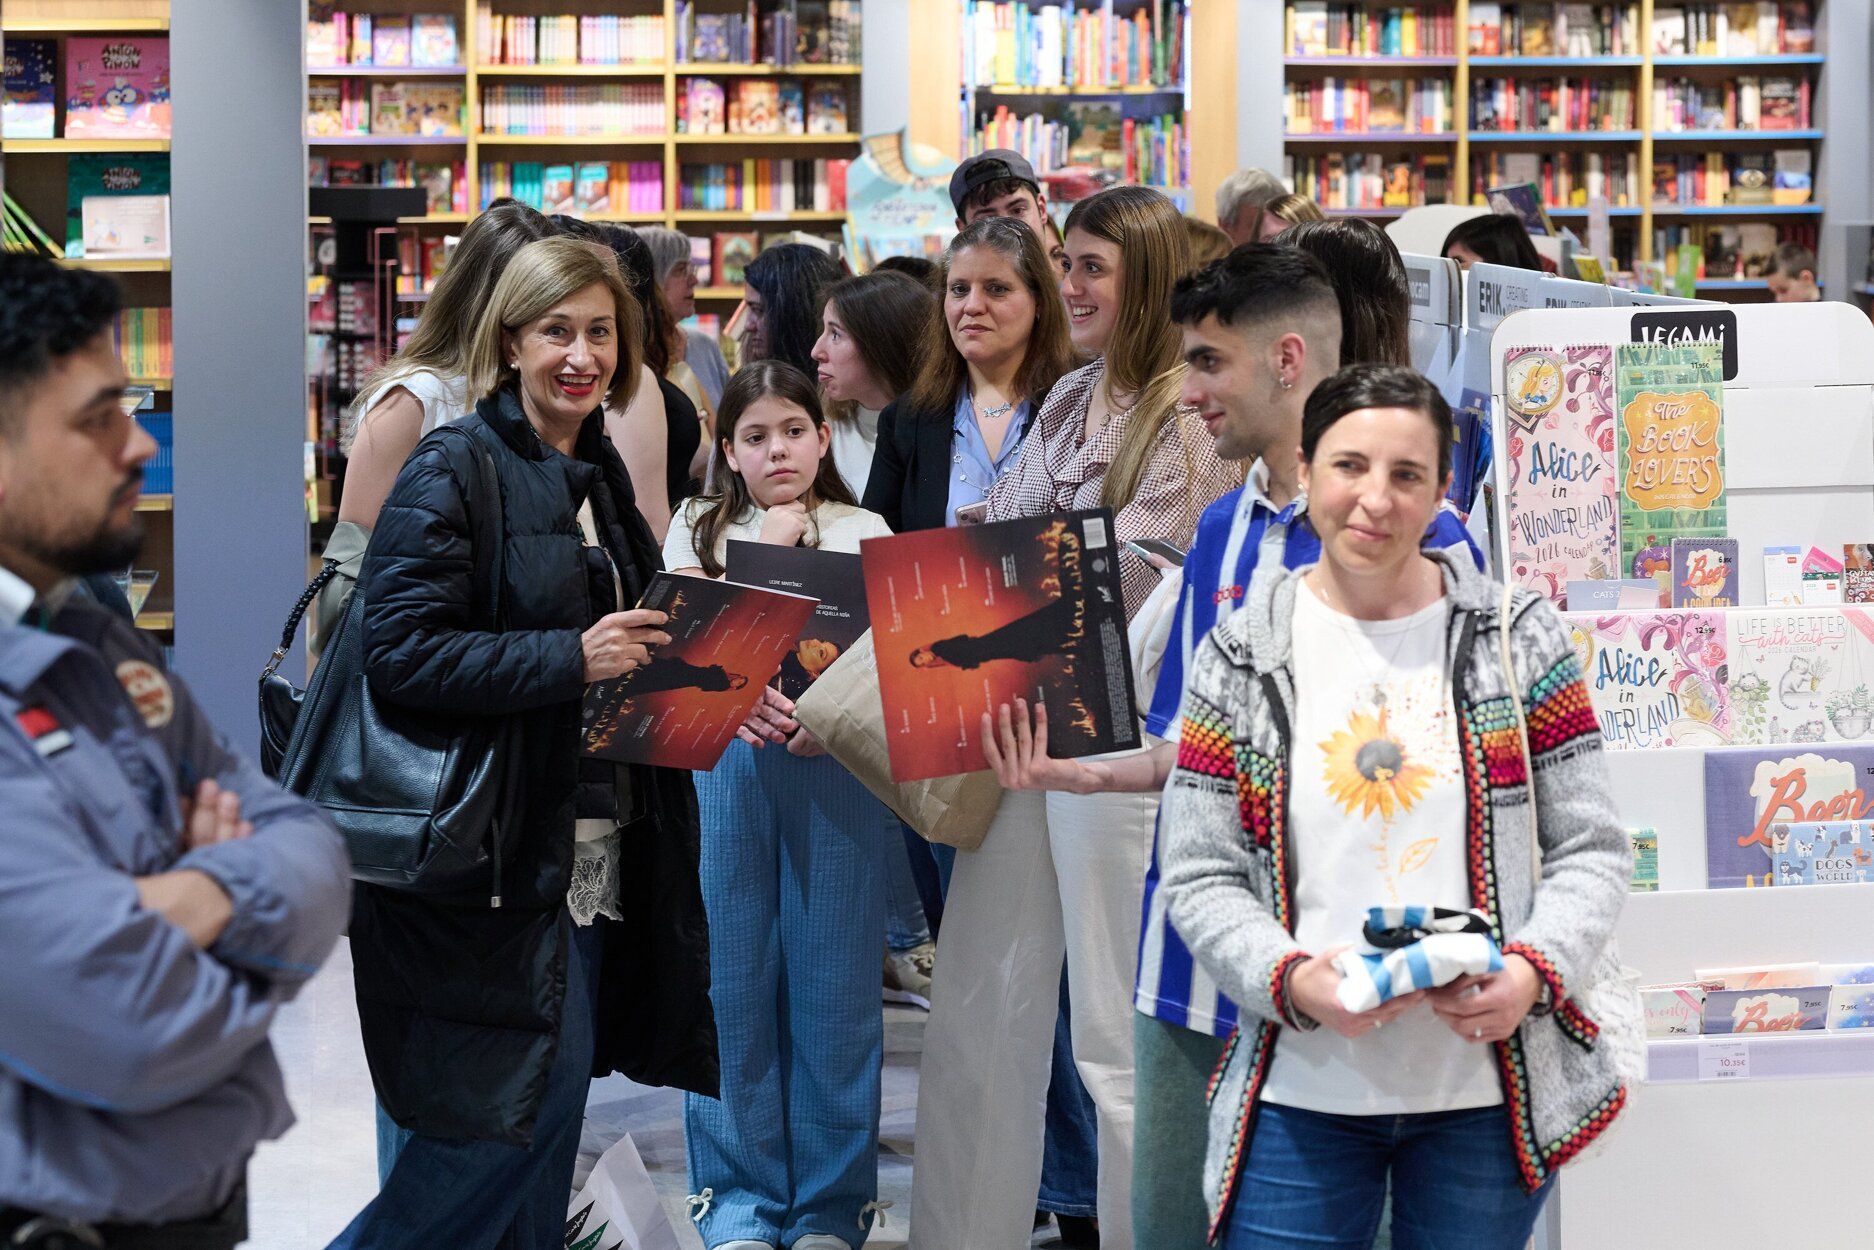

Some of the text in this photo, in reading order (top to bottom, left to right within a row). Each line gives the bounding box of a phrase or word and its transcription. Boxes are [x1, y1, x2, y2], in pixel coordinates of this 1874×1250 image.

[1655, 400, 1694, 421] The
[1636, 421, 1713, 455] BOOK
[1529, 440, 1602, 486] Alice
[1552, 483, 1568, 499] in
[1517, 494, 1614, 547] WONDERLAND
[1536, 541, 1594, 564] 2026 CALENDAR
[1593, 590, 1614, 599] CATS
[1737, 617, 1768, 636] LIFE
[1787, 615, 1848, 635] BETTER
[1595, 646, 1669, 690] Alice
[1618, 689, 1634, 703] in
[1816, 859, 1853, 870] DOGS
[1816, 872, 1853, 881] WORLD
[1719, 1058, 1746, 1067] 10.35€
